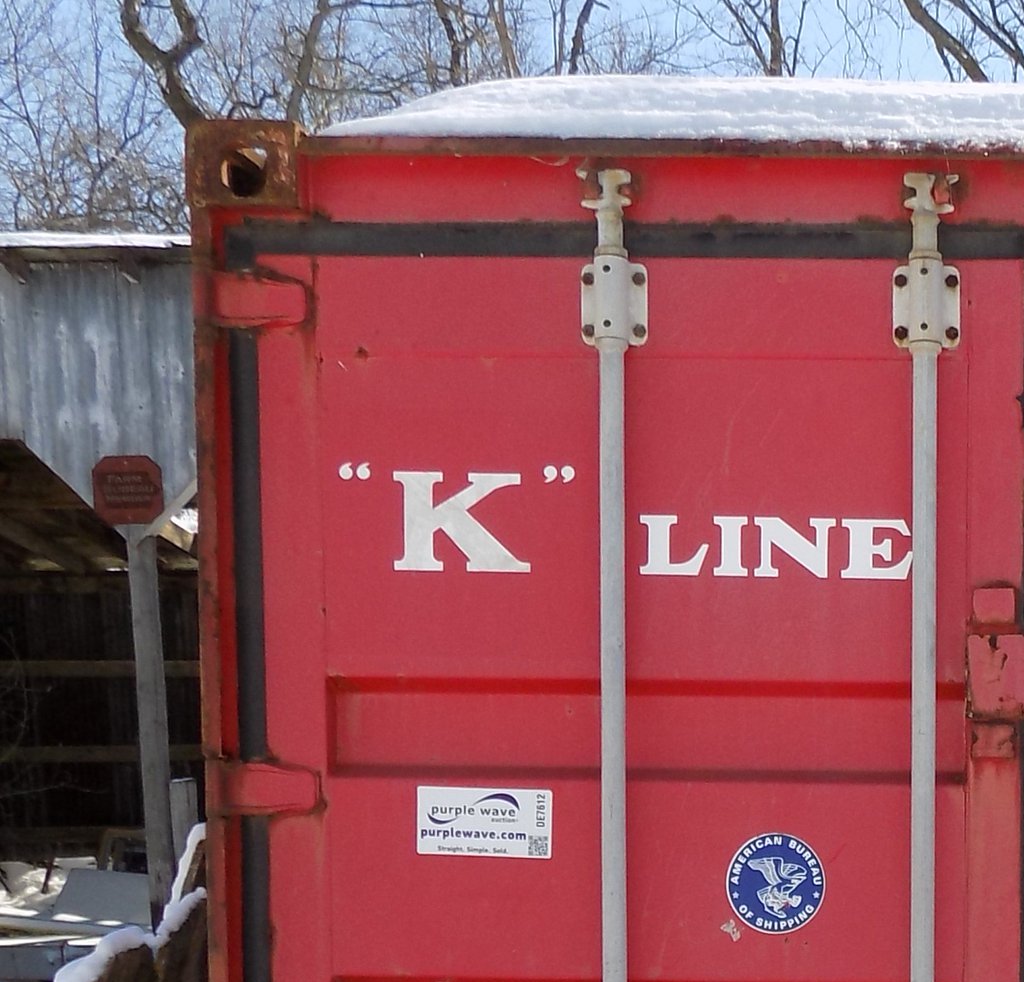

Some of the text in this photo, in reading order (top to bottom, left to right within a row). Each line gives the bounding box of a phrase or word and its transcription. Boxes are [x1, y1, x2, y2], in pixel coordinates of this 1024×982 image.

[639, 514, 913, 580] LINE
[431, 805, 516, 817] purple wave
[420, 827, 527, 840] purplewave.com
[730, 835, 823, 886] AMERICAN BUREAU
[738, 904, 815, 930] OF SHIPPING
